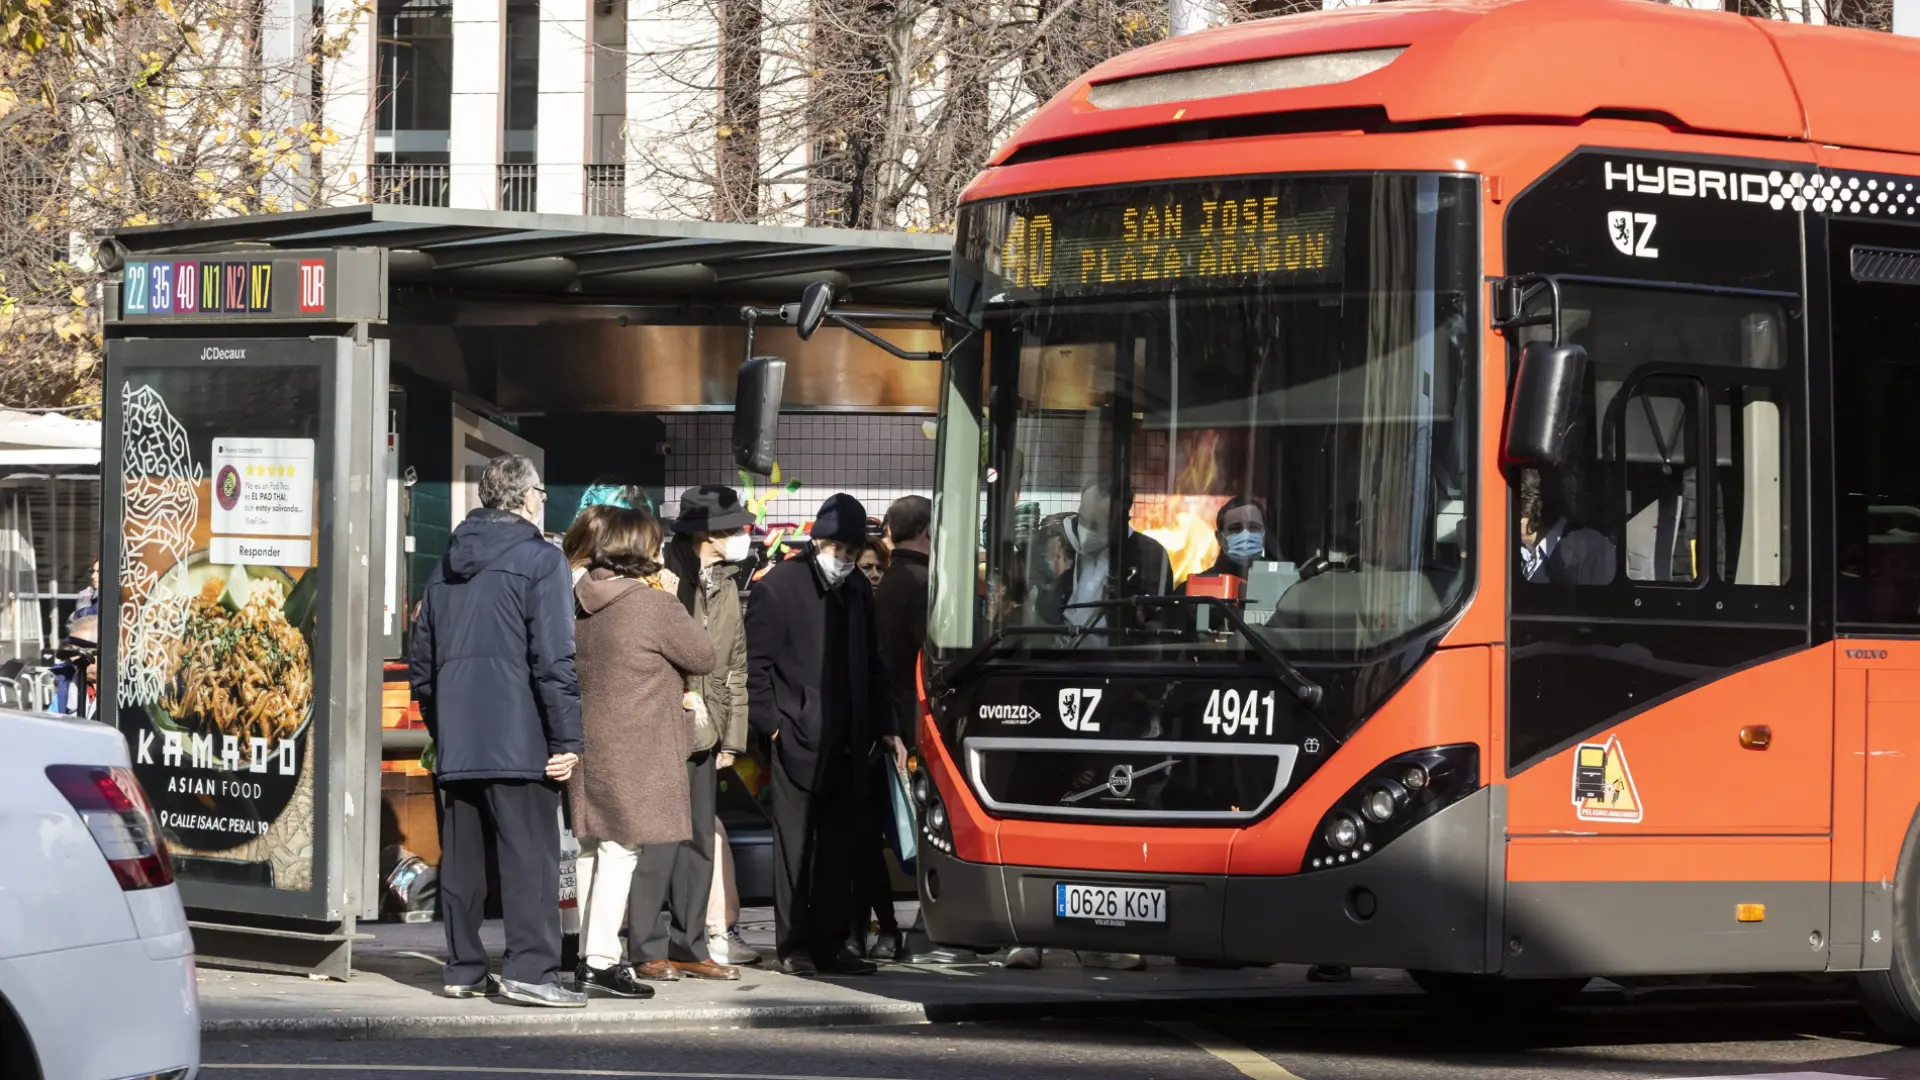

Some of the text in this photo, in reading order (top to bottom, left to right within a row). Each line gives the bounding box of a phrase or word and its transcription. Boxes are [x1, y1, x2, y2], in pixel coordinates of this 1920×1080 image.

[1604, 161, 1769, 203] HYBRID
[1000, 197, 1279, 288] 40 SAN JOSE
[1082, 232, 1324, 284] PLAZA ARAGON
[127, 264, 325, 310] 22 35 40 N1 N2 N7 TUR
[200, 347, 246, 361] JCDecaux
[251, 492, 258, 501] EL
[260, 492, 273, 501] PAD
[255, 505, 271, 514] estoy
[239, 545, 281, 559] Responder
[1844, 649, 1888, 660] VOLVO
[979, 704, 1028, 719] avanza
[1203, 688, 1275, 736] 4941
[167, 776, 262, 800] ASIAN FOOD
[169, 813, 269, 836] CALLE ISAAC PERAL 19
[1060, 904, 1065, 912] E
[1070, 888, 1162, 919] 0626 KGY
